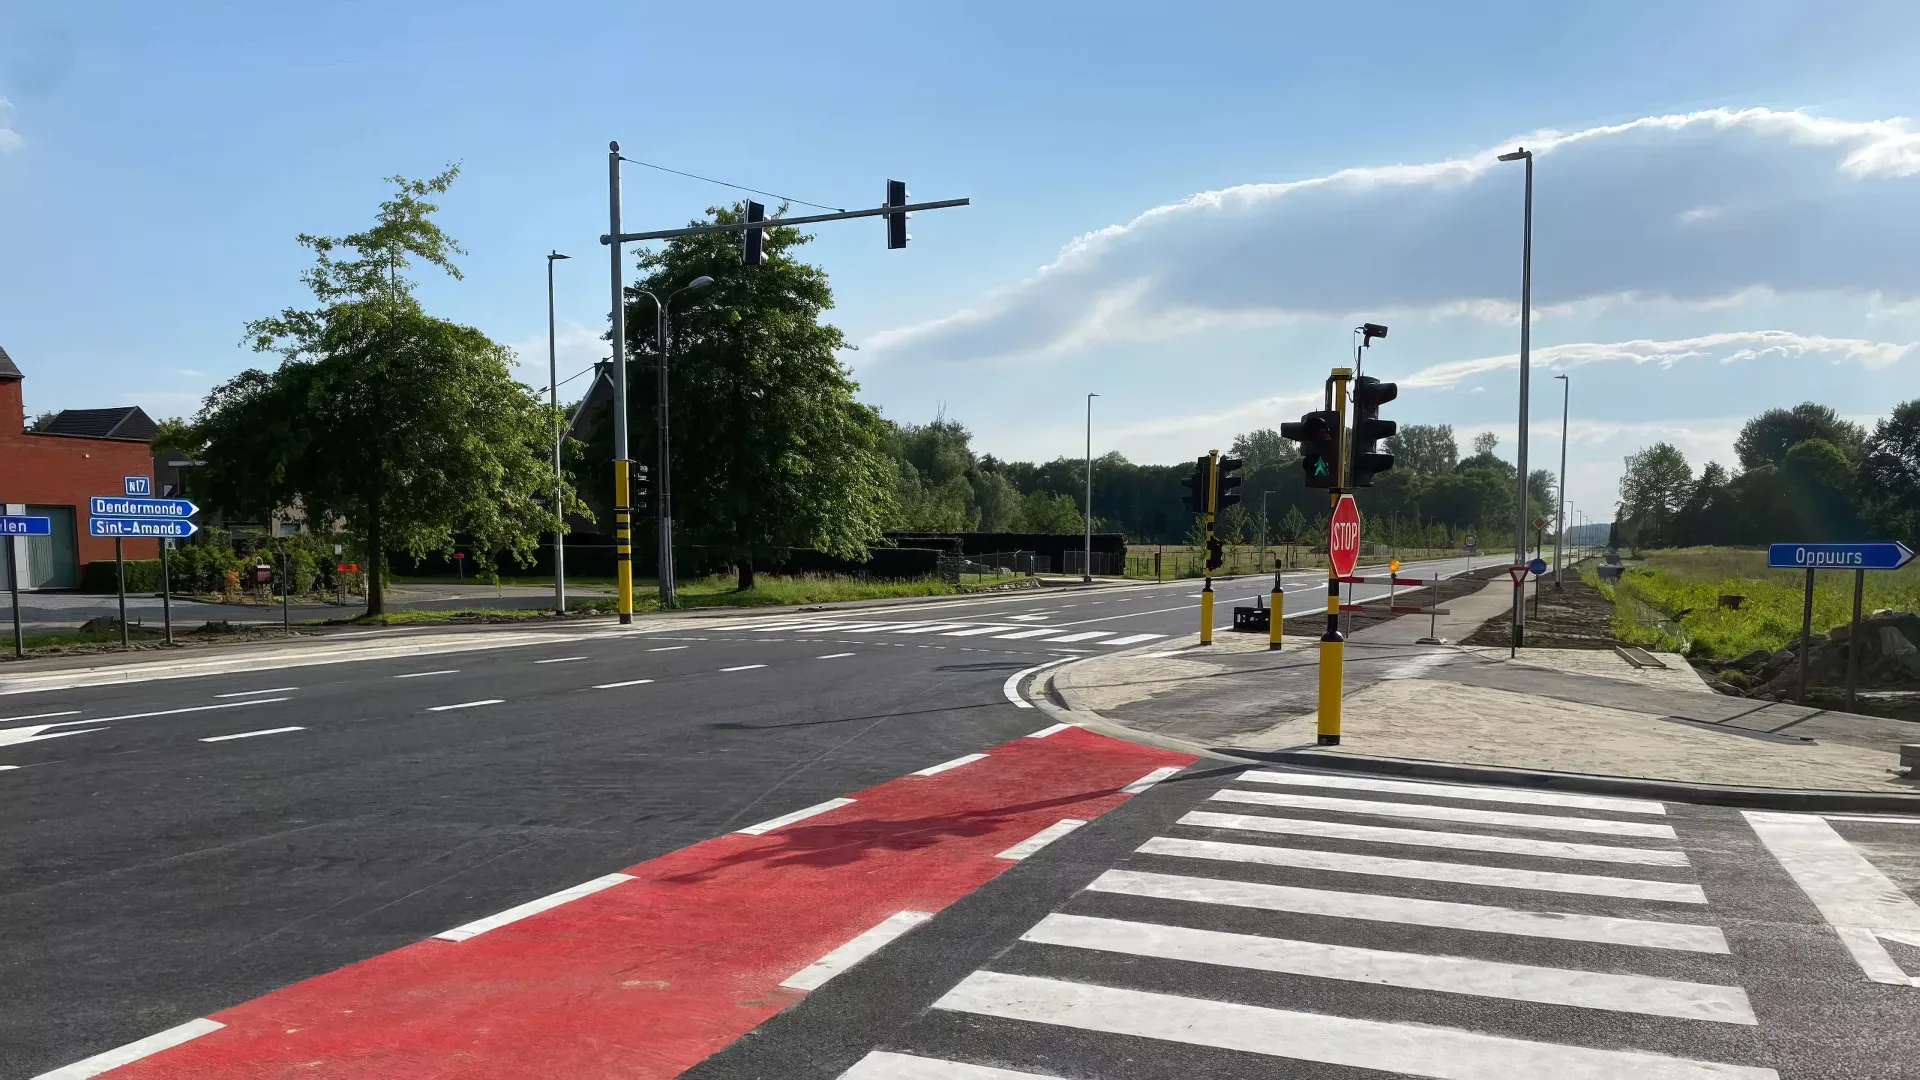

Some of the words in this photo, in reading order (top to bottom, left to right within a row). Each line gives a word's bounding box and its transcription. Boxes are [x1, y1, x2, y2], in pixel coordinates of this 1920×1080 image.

[129, 480, 145, 492] N17
[97, 500, 182, 515] Dendermonde
[96, 521, 182, 535] Sint-Amands
[1333, 522, 1358, 551] STOP
[1796, 547, 1862, 566] Oppuurs
